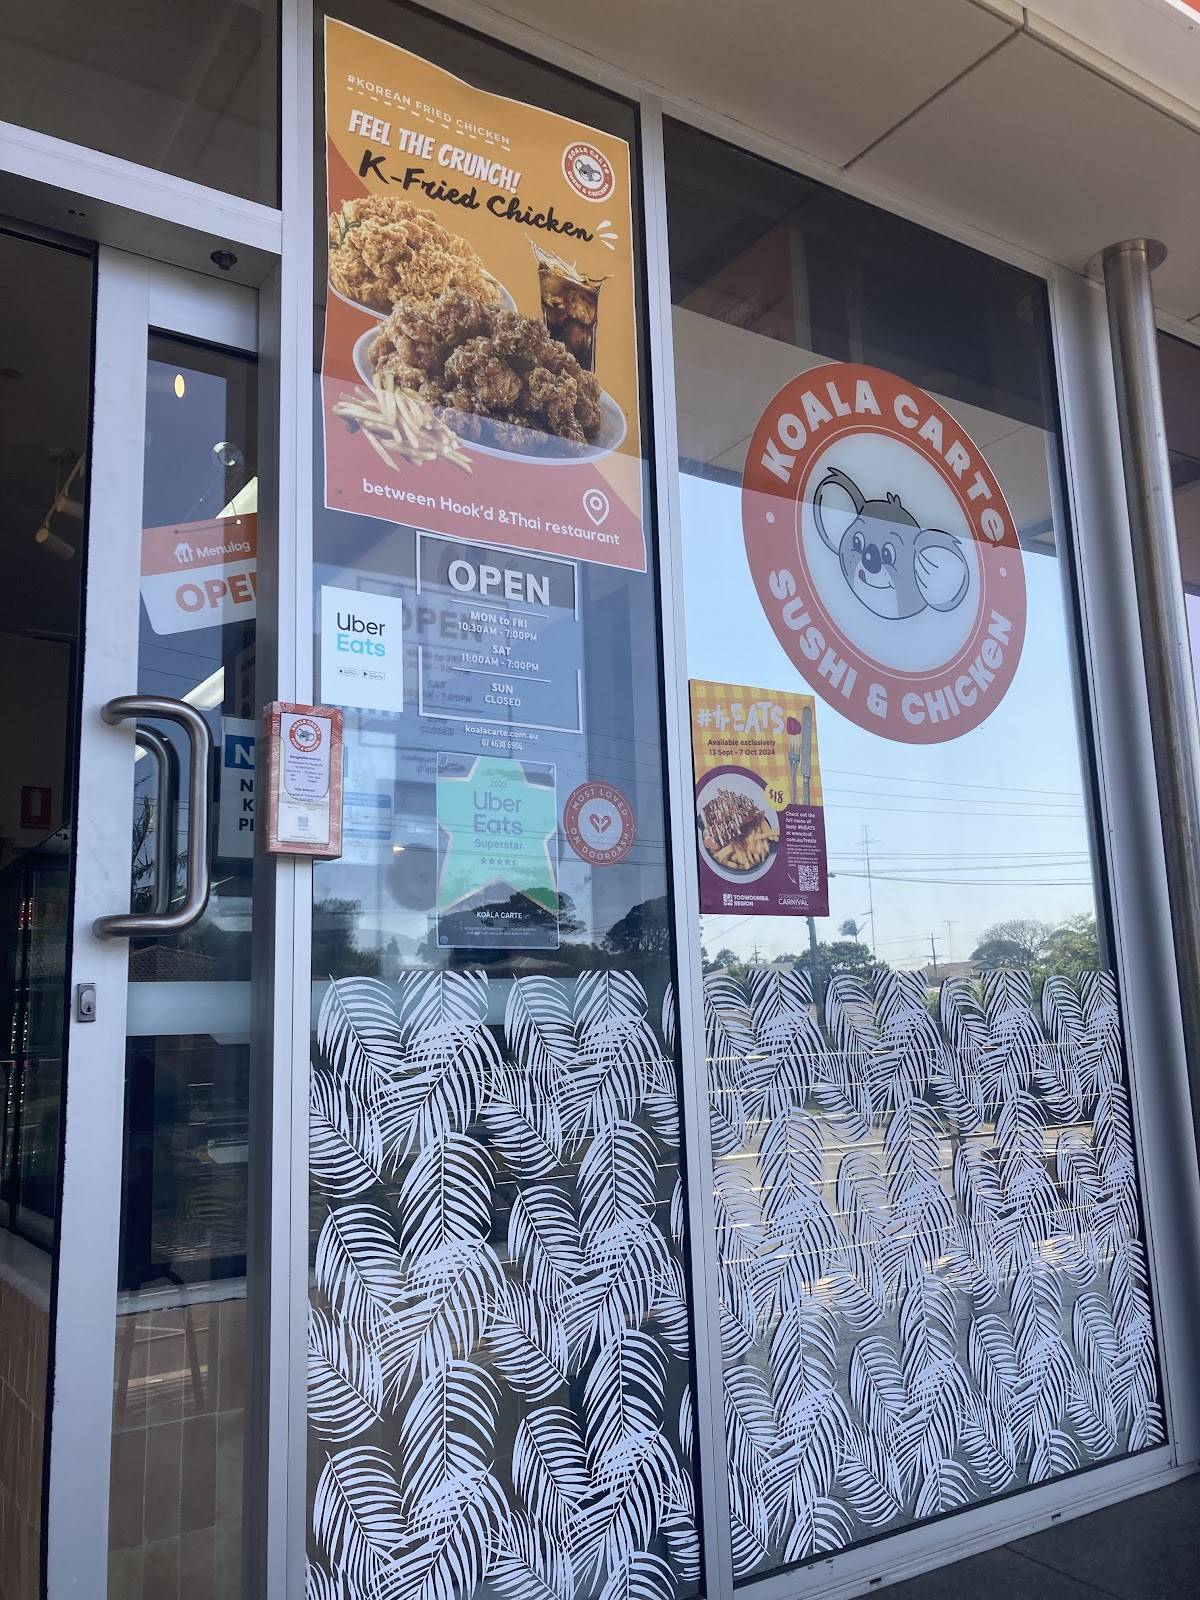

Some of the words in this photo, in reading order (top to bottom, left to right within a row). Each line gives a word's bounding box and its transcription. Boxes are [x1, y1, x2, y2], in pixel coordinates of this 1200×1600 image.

[347, 74, 411, 105] #KOREAN
[415, 101, 451, 122] FRIED
[456, 119, 510, 144] CHICKEN
[348, 109, 391, 147] FEEL
[398, 128, 436, 160] THE
[438, 143, 522, 194] CRUNCH!
[358, 150, 480, 210] K-Fried
[486, 195, 594, 242] Chicken
[760, 379, 882, 484] KOALA
[363, 478, 436, 507] between
[440, 495, 494, 521] Hook'd
[545, 520, 621, 545] restaurant
[196, 541, 251, 559] Menulog
[448, 560, 550, 605] OPEN
[337, 611, 385, 636] Uber
[471, 611, 497, 623] MON
[499, 617, 509, 626] to
[513, 618, 527, 629] FRI
[458, 621, 497, 635] 10:30AM
[505, 629, 537, 641] 7:00PM
[337, 633, 385, 657] Eats
[492, 645, 512, 656] SAT
[769, 568, 858, 699] SUSHI
[866, 683, 888, 719] &
[462, 653, 498, 666] 11:00AM
[506, 660, 539, 672] 7:00PM
[491, 682, 513, 694] SUN
[485, 694, 521, 706] CLOSED
[465, 725, 538, 739] koalacarte.com.au
[718, 749, 733, 757] Sept
[740, 739, 775, 747] exclusively
[473, 791, 522, 812] Uber
[572, 788, 595, 810] MOST
[600, 788, 627, 815] LOVED
[769, 789, 783, 803] $18
[474, 814, 524, 835] Eats
[474, 838, 523, 850] Superstar
[571, 828, 581, 844] ON
[582, 833, 629, 860] DOORDASH
